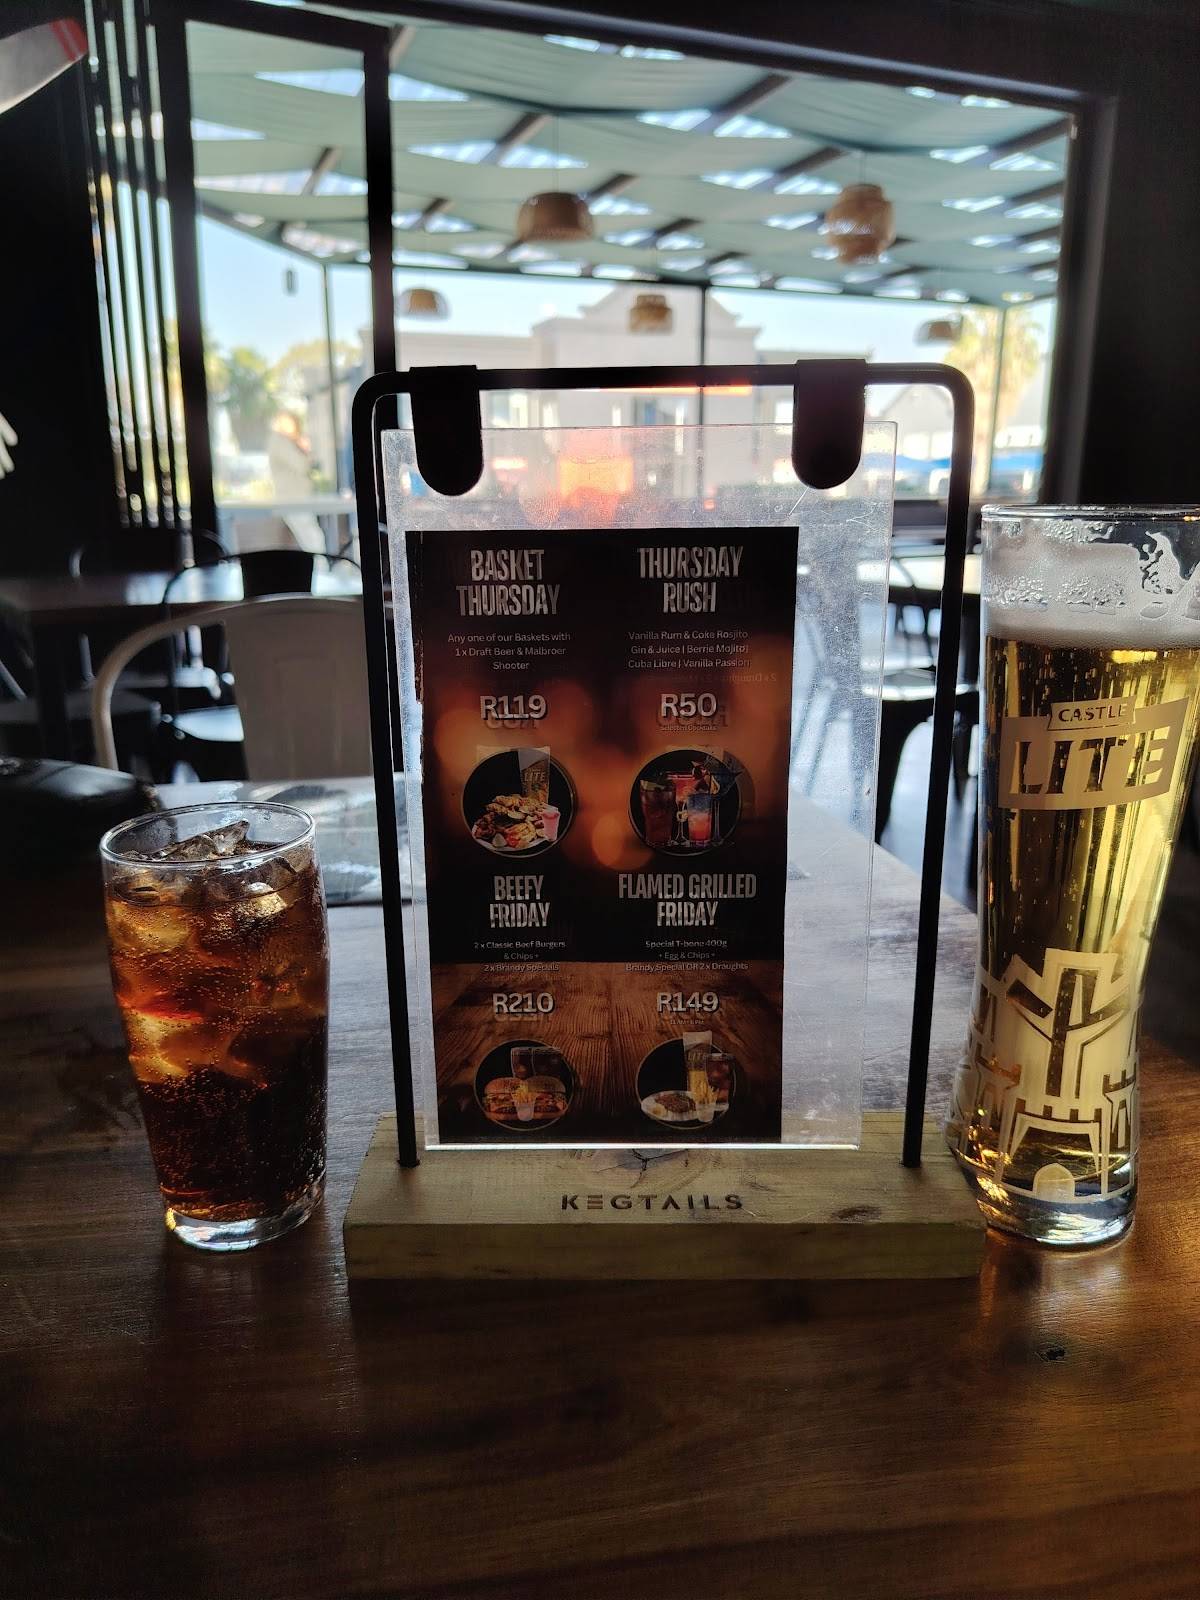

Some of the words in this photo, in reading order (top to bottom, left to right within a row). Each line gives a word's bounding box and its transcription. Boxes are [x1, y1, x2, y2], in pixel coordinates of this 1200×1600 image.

[470, 549, 545, 581] BASKET
[638, 546, 743, 579] THURSDAY
[456, 584, 560, 616] THURSDAY
[663, 581, 717, 613] RUSH
[447, 634, 466, 644] Any
[468, 634, 485, 642] one
[486, 633, 497, 642] of
[514, 632, 550, 642] Baskets
[550, 632, 571, 641] with
[628, 630, 660, 640] Vanilla
[661, 631, 682, 640] Rum
[684, 631, 690, 639] &
[692, 630, 715, 639] Coke
[468, 648, 492, 656] Draft
[494, 647, 514, 656] Beer
[516, 648, 524, 656] &
[631, 646, 647, 654] Gin
[648, 646, 654, 654] &
[656, 646, 681, 654] Juice
[687, 644, 714, 654] Berrie
[716, 644, 746, 656] Mojito
[493, 662, 530, 670] Shooter
[628, 660, 652, 668] Cuba
[653, 659, 677, 668] Libre
[683, 658, 714, 668] Vanilla
[716, 658, 750, 668] Passion
[479, 694, 548, 719] R119
[660, 692, 717, 718] R50
[1058, 703, 1128, 723] CASTLE
[1009, 725, 1171, 795] LITE
[494, 874, 544, 901] BEEFY
[618, 873, 684, 899] FLAMED
[688, 873, 757, 899] GRILLED
[490, 902, 550, 928] FRIDAY
[656, 901, 718, 927] FRIDAY
[486, 941, 514, 949] Classic
[516, 940, 534, 948] Beef
[535, 940, 566, 950] Burgers
[646, 940, 674, 950] Special
[705, 939, 728, 948] 400g
[510, 952, 534, 961] Chips
[664, 952, 678, 960] Egg
[687, 952, 710, 960] Chips
[712, 962, 748, 971] Draughts
[492, 992, 554, 1013] R210
[656, 992, 720, 1012] R149
[561, 1194, 743, 1210] KEGTAILS
